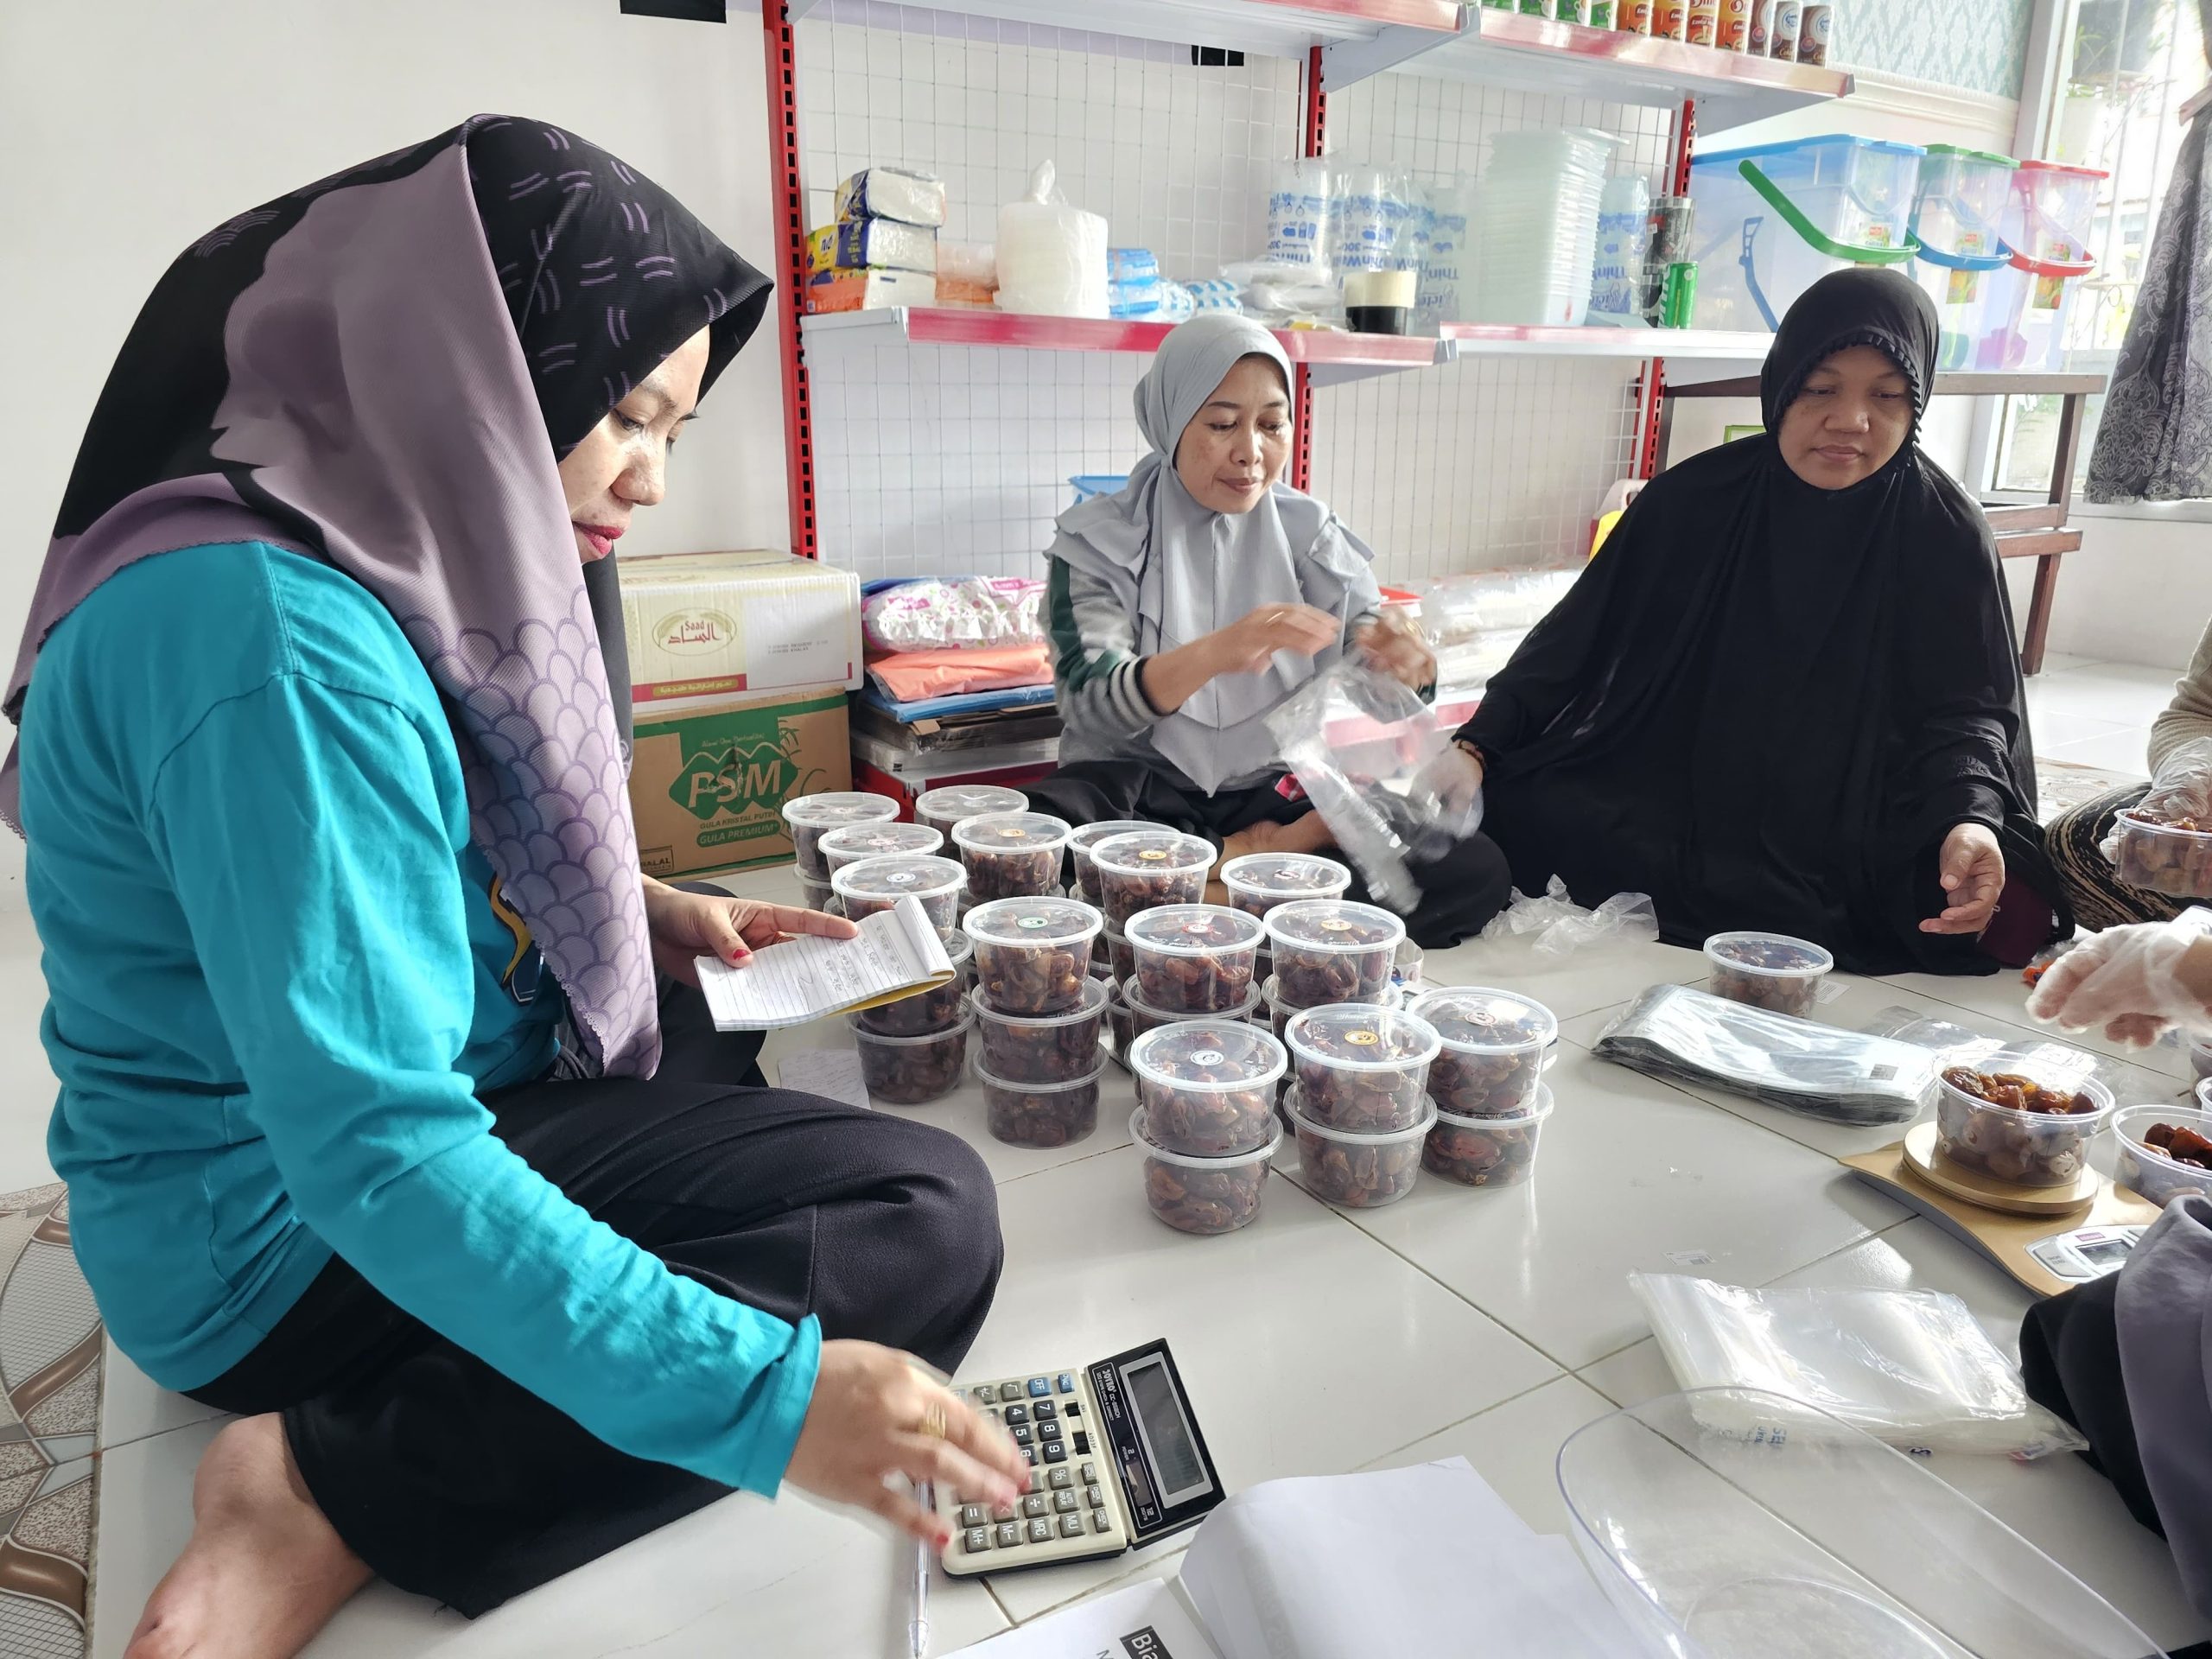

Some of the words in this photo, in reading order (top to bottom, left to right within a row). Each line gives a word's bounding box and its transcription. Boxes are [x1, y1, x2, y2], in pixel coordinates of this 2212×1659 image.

[684, 620, 705, 631] Saad
[689, 760, 781, 808] PSM
[699, 820, 721, 830] GULA
[721, 814, 753, 827] KRISTAL
[699, 833, 725, 845] GULA
[728, 823, 774, 839] PREMIUM
[1034, 1378, 1046, 1390] OFF
[1102, 1369, 1116, 1392] JOYKO
[1012, 1408, 1023, 1416] 4
[1015, 1427, 1027, 1437] 5
[1044, 1424, 1056, 1433] 8
[1020, 1449, 1032, 1458] 6
[1048, 1444, 1060, 1453] 9
[1054, 1469, 1066, 1481] %
[1065, 1492, 1074, 1503] AUTO
[1146, 1507, 1154, 1516] 12
[1033, 1519, 1046, 1536] MRC
[1065, 1515, 1079, 1529] MU
